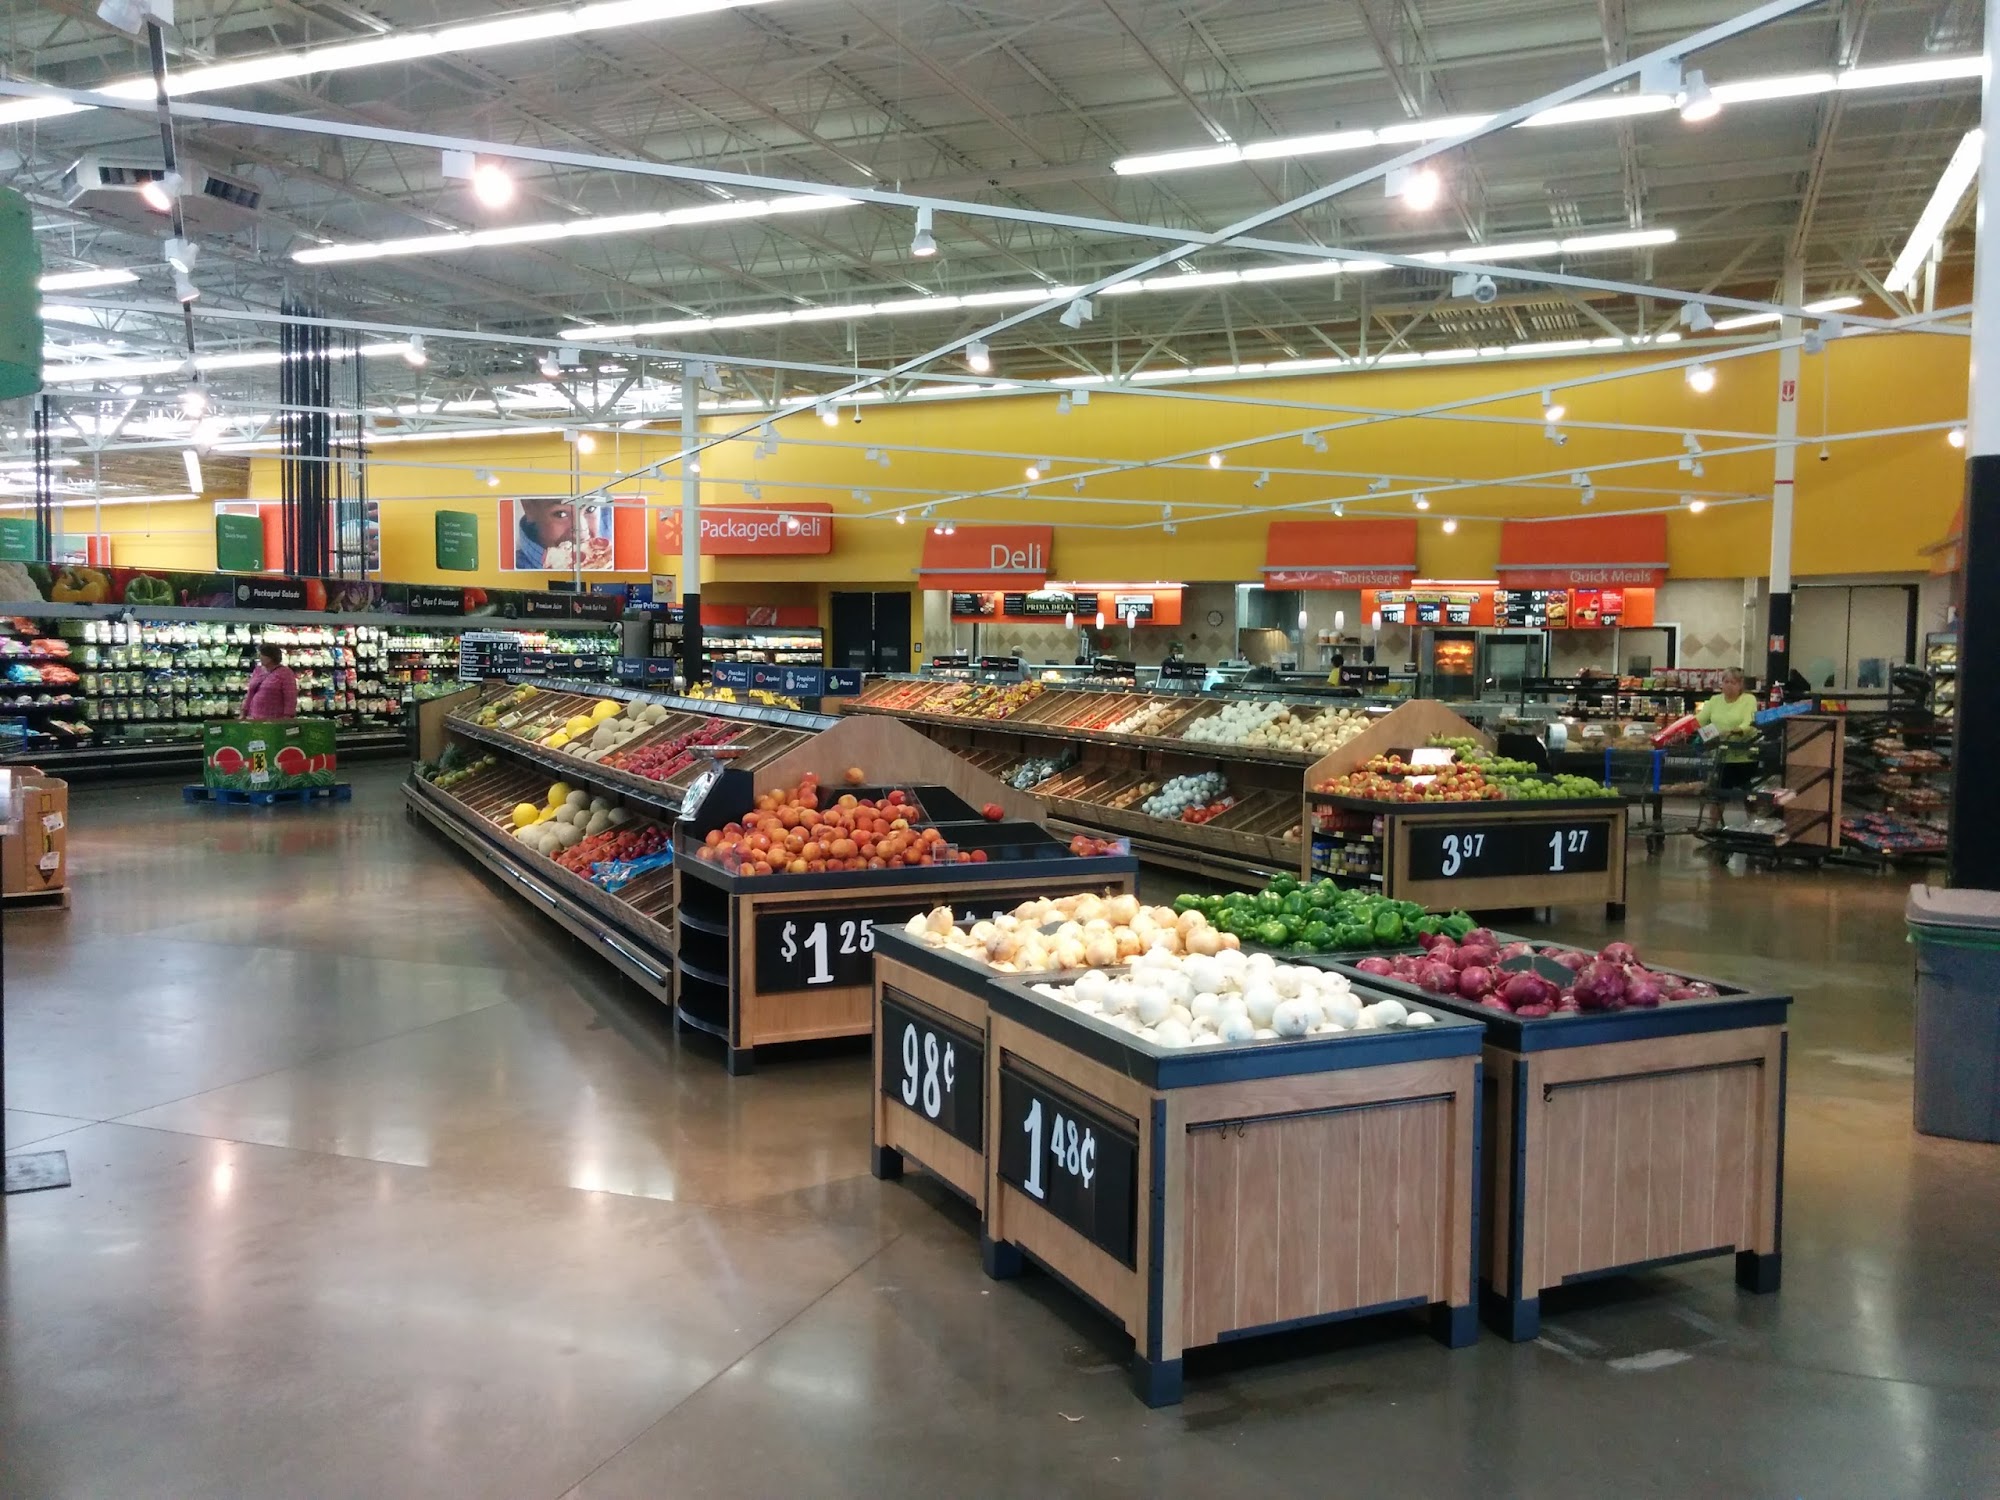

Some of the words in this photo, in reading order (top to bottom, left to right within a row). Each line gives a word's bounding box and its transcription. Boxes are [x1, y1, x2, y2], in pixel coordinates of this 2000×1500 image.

[700, 519, 781, 541] Packaged
[786, 516, 821, 537] Deli
[990, 543, 1041, 569] Deli
[253, 559, 260, 569] 2
[1341, 573, 1400, 585] Rotisserie
[1570, 570, 1609, 583] Quick
[1611, 571, 1650, 582] Meals
[253, 588, 281, 600] Packaged
[281, 590, 300, 599] Salads
[438, 598, 459, 608] Dressings
[535, 601, 553, 609] Premium
[796, 675, 816, 683] Tropical
